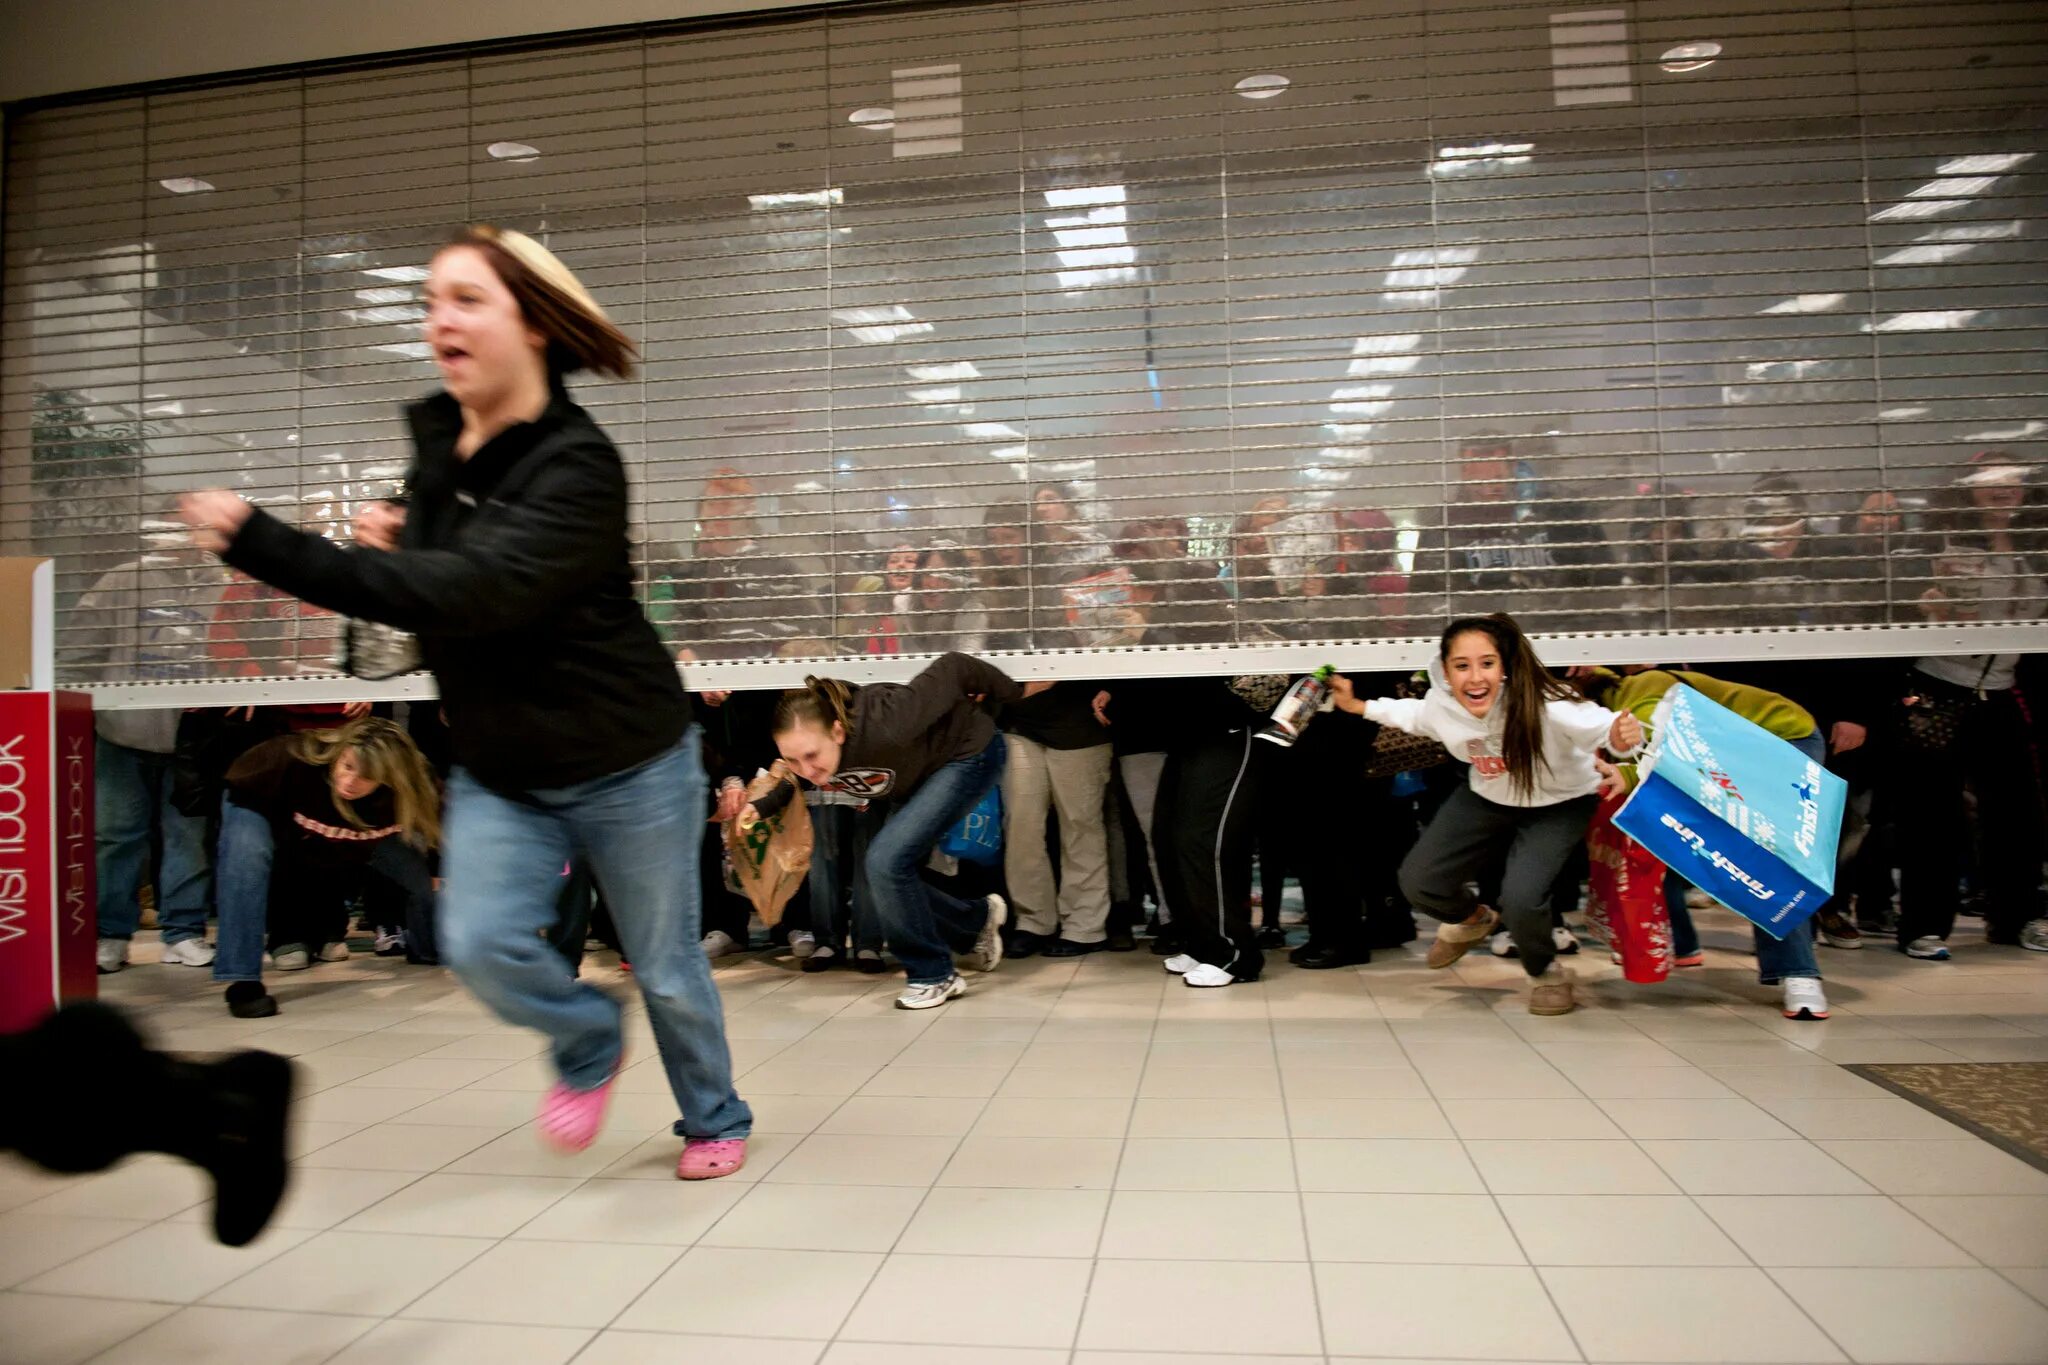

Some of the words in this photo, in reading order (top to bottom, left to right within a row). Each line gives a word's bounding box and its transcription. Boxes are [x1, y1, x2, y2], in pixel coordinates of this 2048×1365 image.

[1801, 761, 1822, 796] Line
[66, 736, 86, 935] wishbook
[1660, 813, 1706, 851] Line
[1794, 800, 1818, 857] Finish
[1711, 850, 1776, 900] Finish
